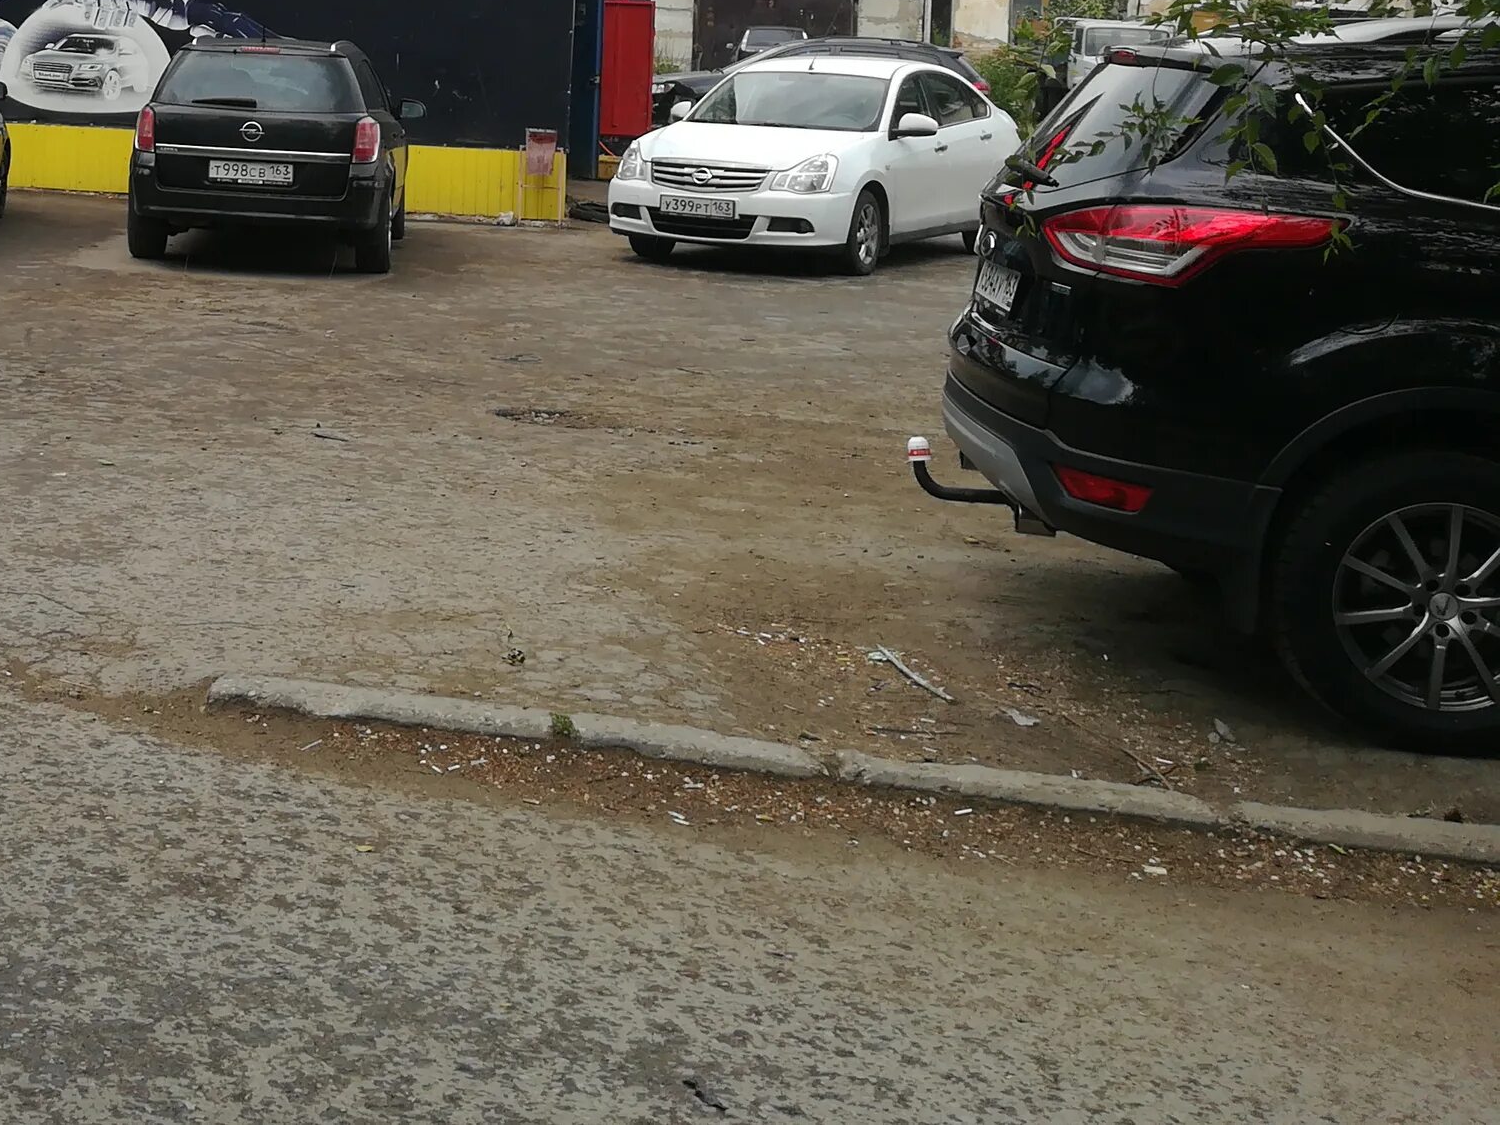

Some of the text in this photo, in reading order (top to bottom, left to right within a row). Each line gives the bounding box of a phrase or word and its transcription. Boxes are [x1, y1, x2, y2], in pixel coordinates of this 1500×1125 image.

[214, 162, 290, 178] Т998СВ 163
[665, 198, 732, 214] У399РТ 163
